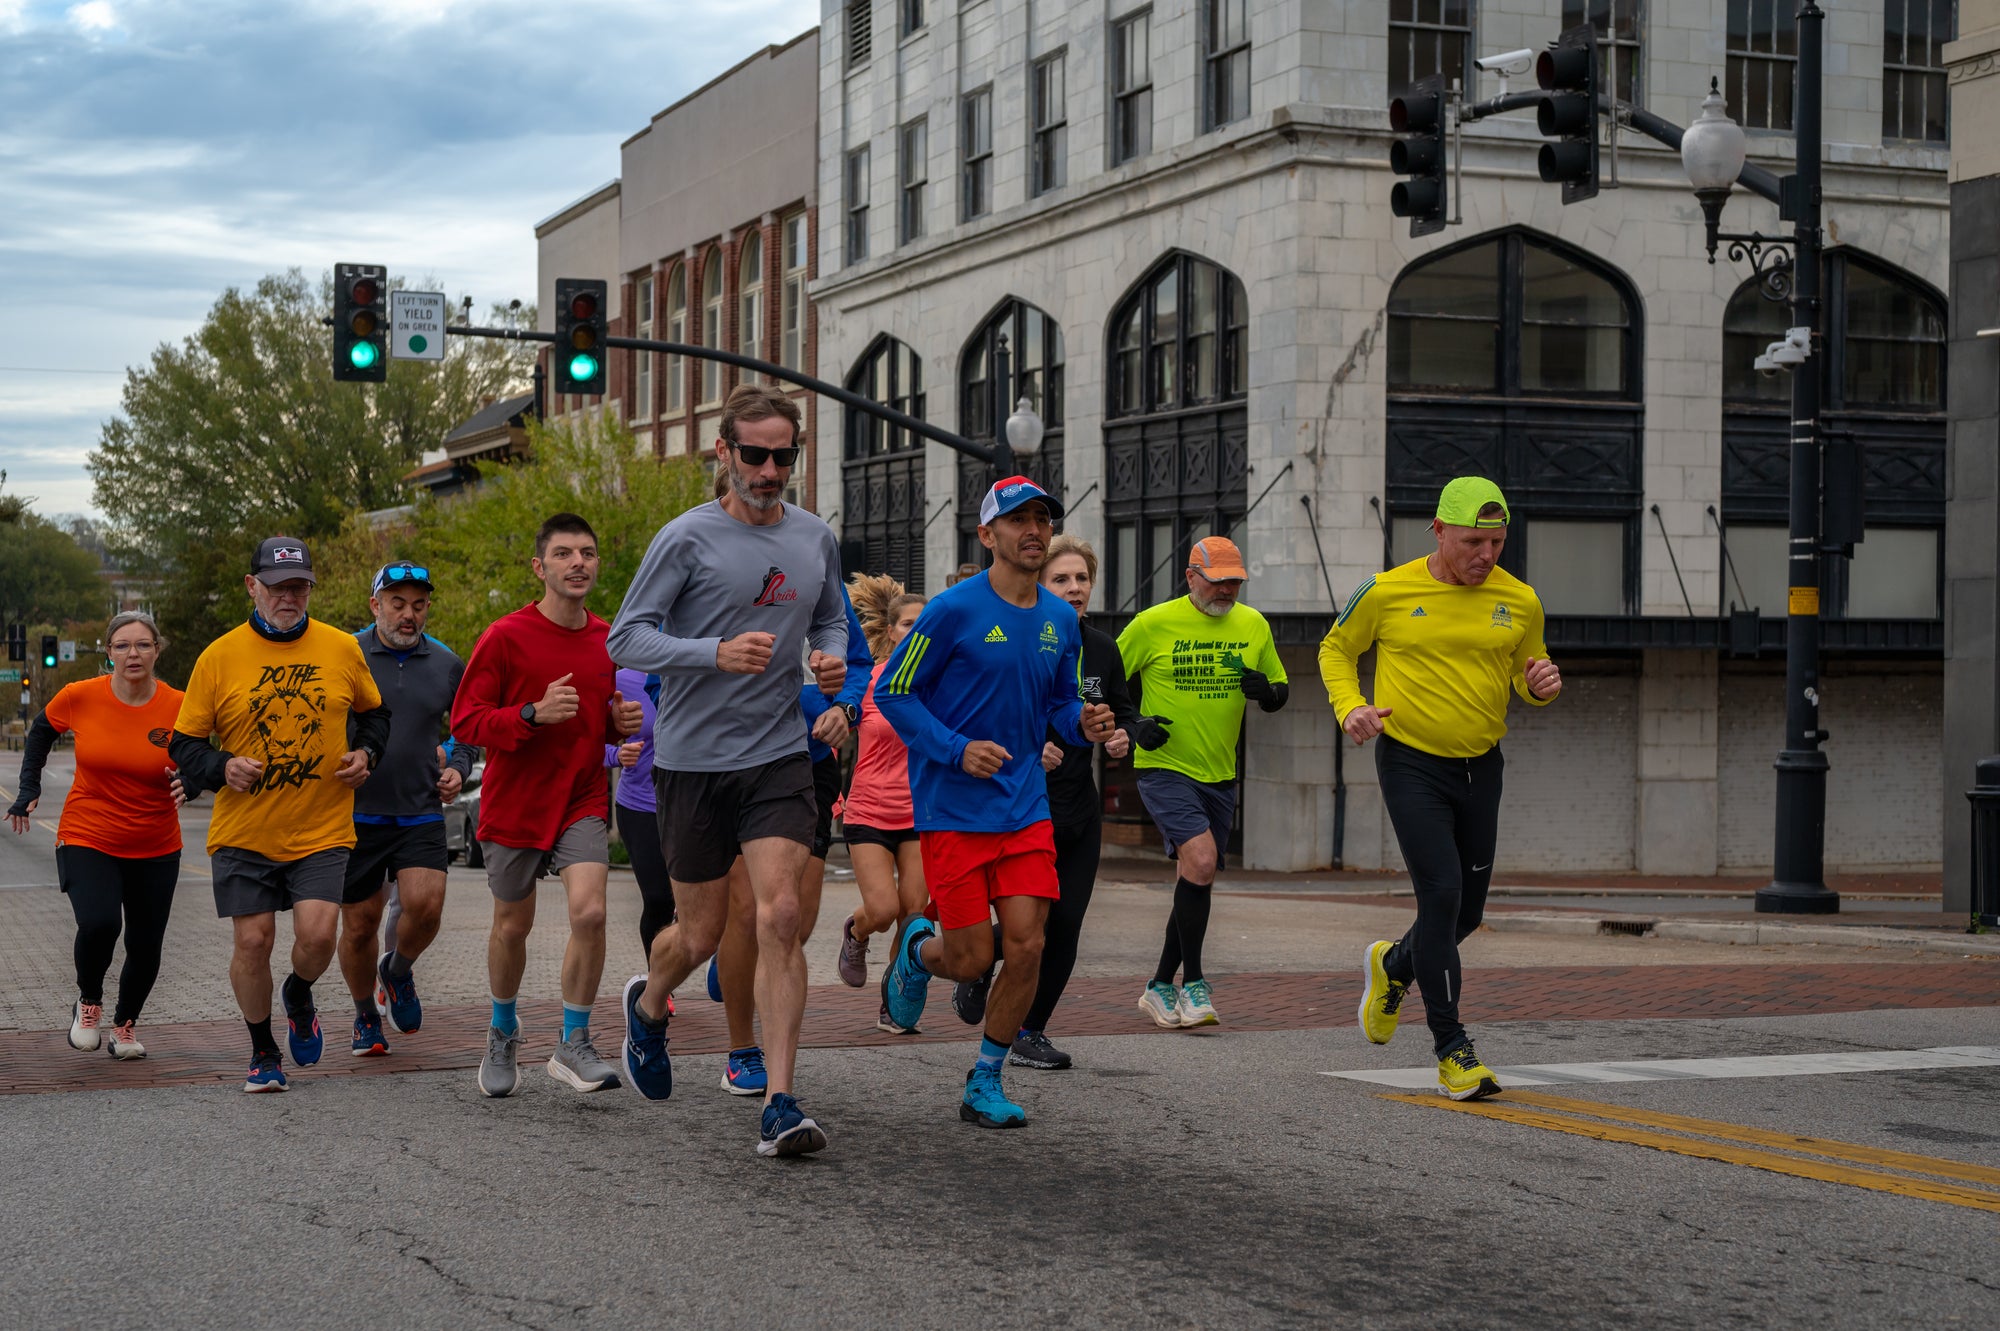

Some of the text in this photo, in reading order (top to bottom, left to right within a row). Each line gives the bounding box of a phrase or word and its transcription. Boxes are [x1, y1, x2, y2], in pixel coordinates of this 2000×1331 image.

[397, 296, 439, 307] LEFT TURN
[404, 308, 433, 320] YIELD
[398, 322, 438, 332] ON GREEN
[1172, 639, 1191, 654] 21st
[1172, 653, 1215, 666] RUN FOR
[1172, 665, 1216, 677] JUSTICE
[249, 664, 323, 692] DO THE
[1174, 684, 1223, 692] PROFESSIONAL
[250, 755, 325, 797] WORK
